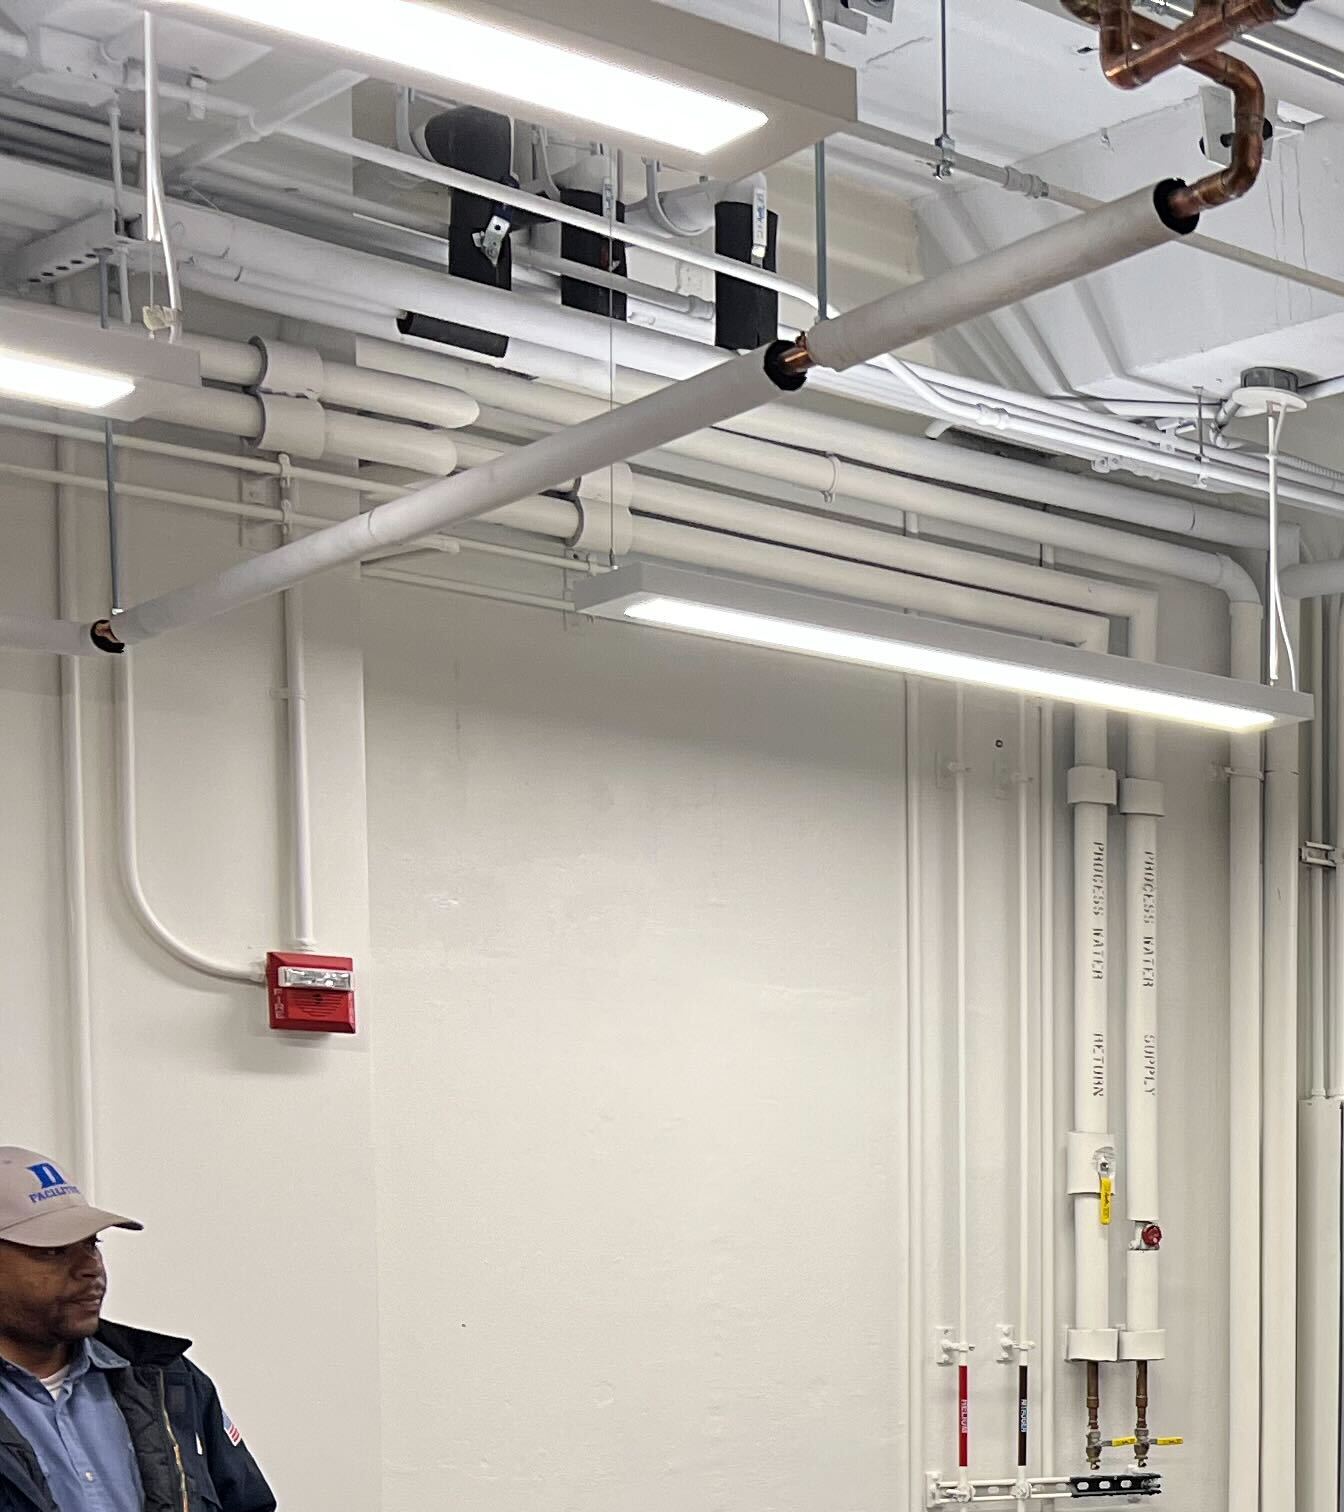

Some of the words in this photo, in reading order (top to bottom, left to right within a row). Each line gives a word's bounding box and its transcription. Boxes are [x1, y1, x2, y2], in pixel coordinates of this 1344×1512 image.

[1092, 842, 1105, 917] PROCESS
[1142, 850, 1156, 925] PROCESS
[1091, 927, 1105, 981] WATER
[1142, 936, 1156, 988] WATER
[1091, 1032, 1105, 1098] RETURN
[1143, 1034, 1156, 1097] SUPPLY
